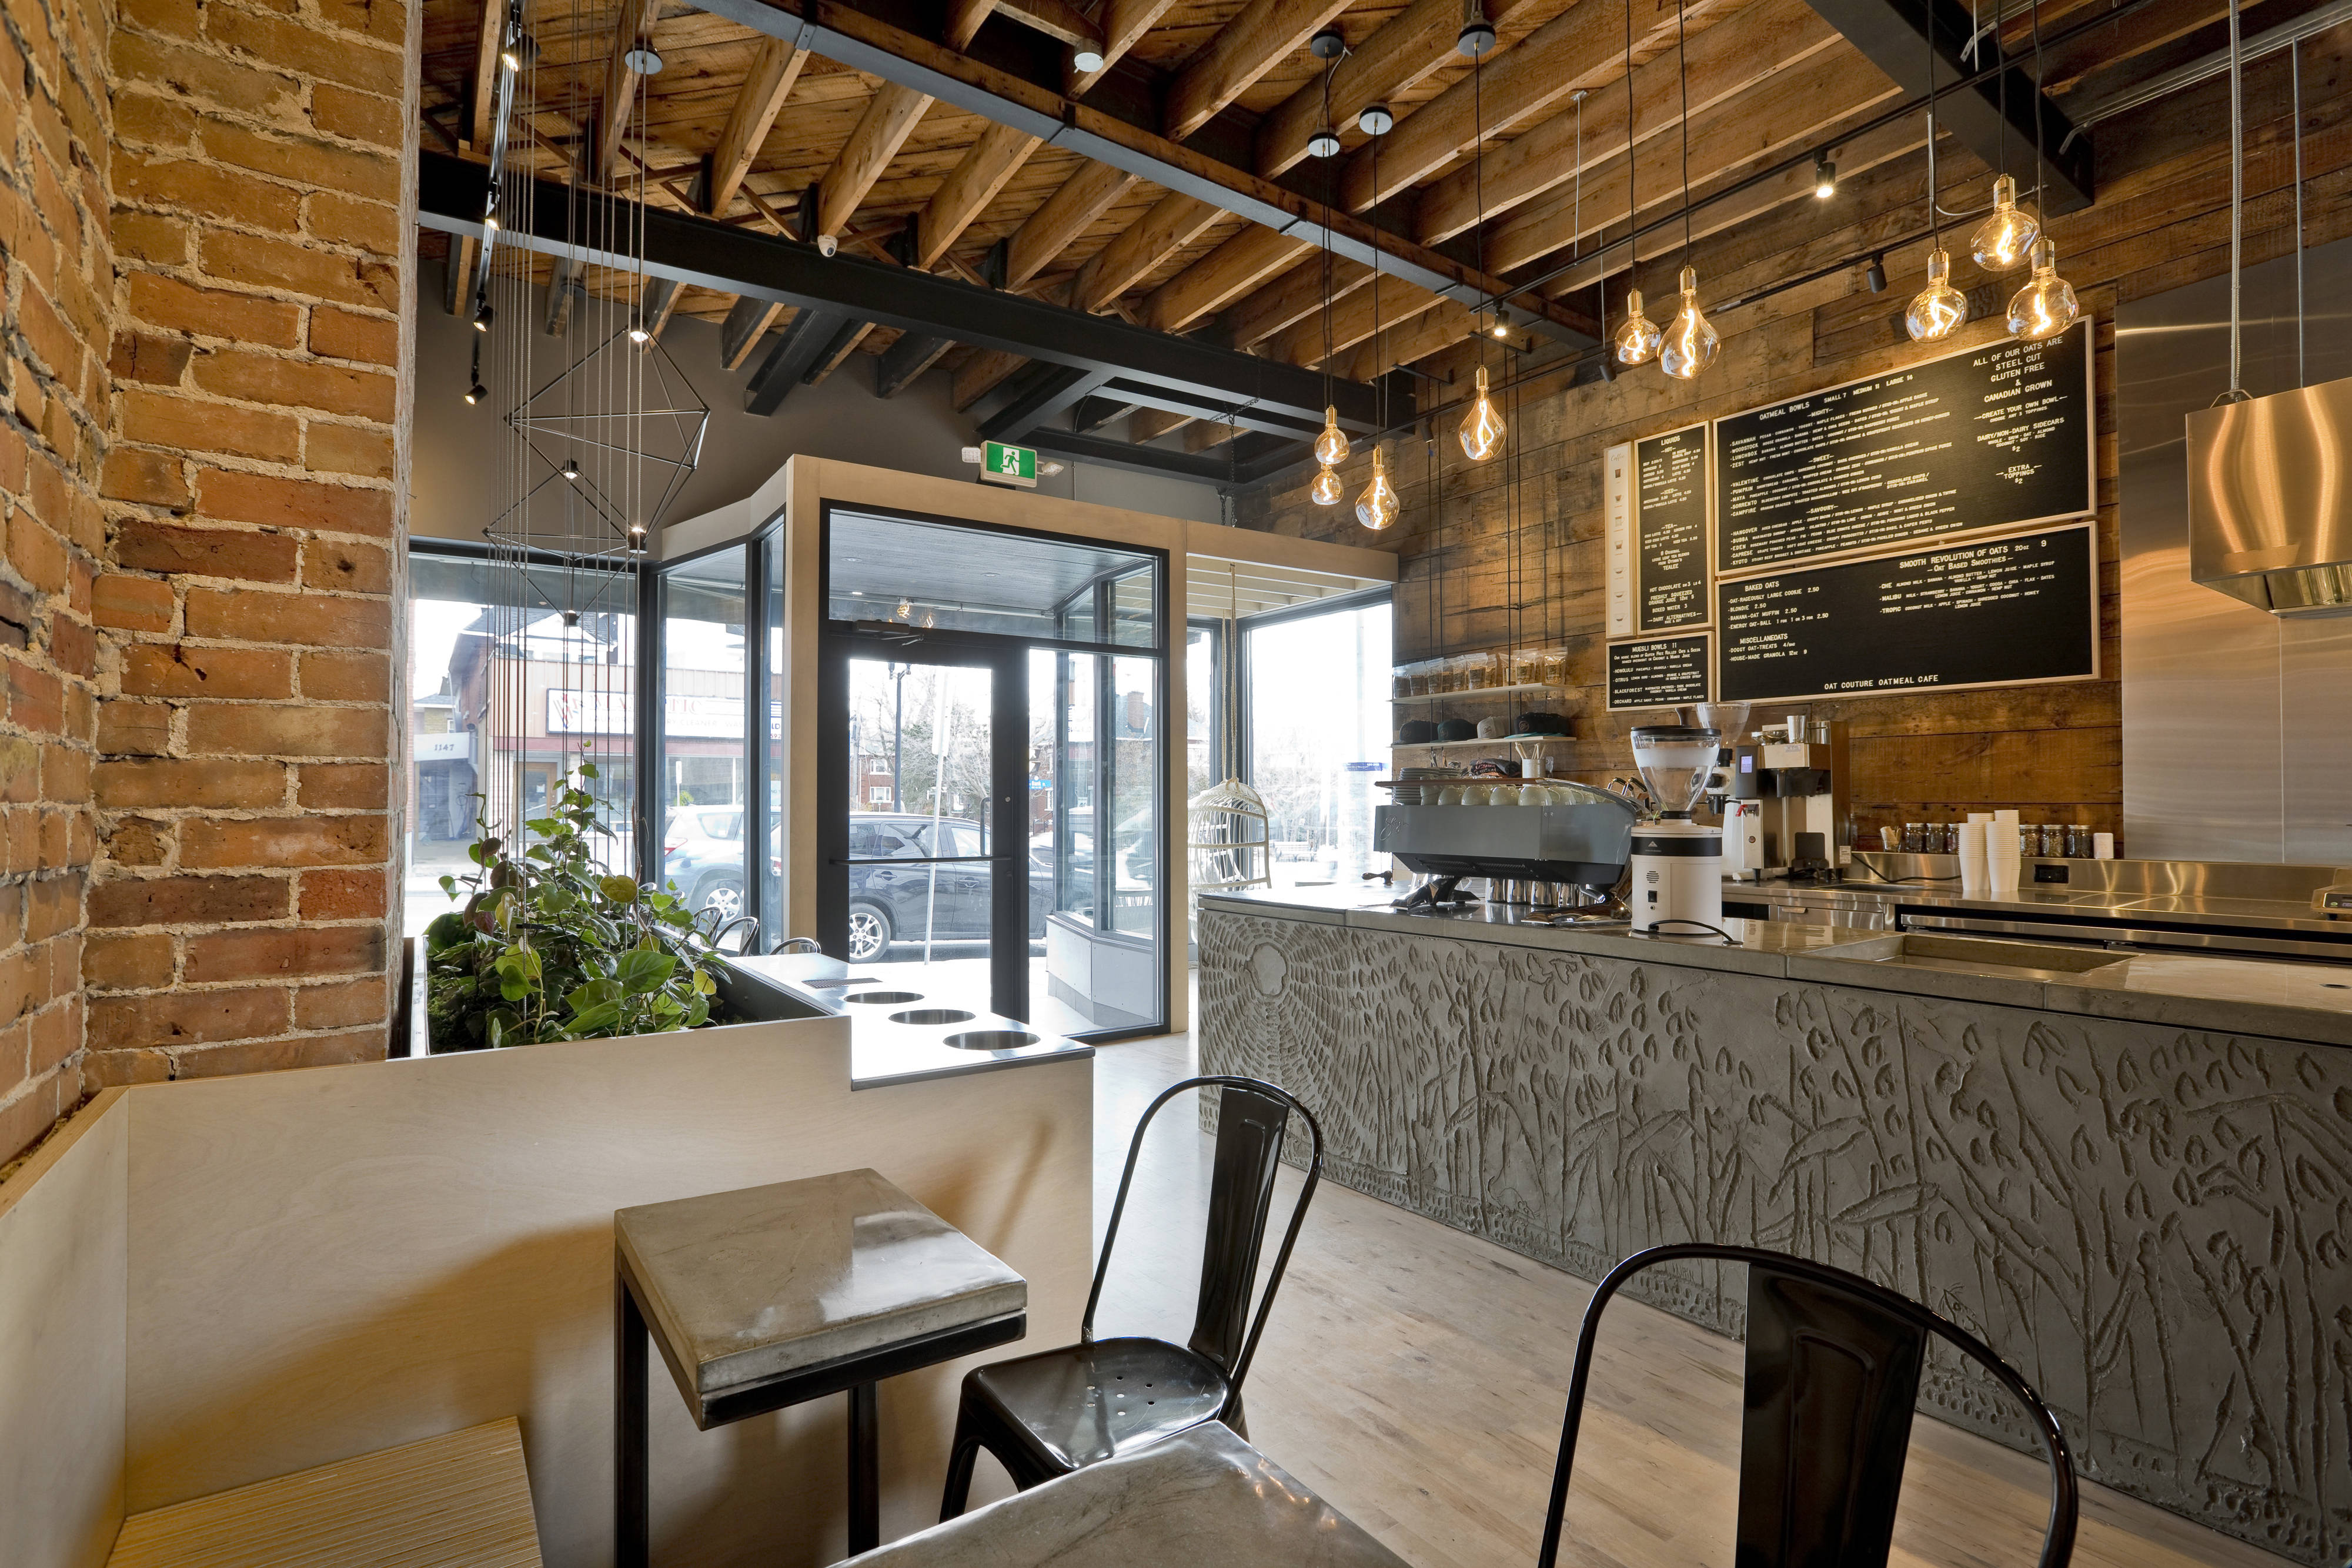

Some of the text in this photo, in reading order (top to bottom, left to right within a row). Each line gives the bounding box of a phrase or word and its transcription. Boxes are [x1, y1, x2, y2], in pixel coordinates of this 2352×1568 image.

[1973, 336, 2063, 366] ALL OF OUR OATS ARE
[1995, 352, 2042, 370] STEEL CUT
[1990, 362, 2044, 382] GLUTEN FREE
[1984, 379, 2052, 402] CANADIAN GROWN
[1759, 408, 1786, 420] OATMEAL
[1789, 401, 1809, 412] BOWLS
[1823, 394, 1841, 403] SMALL
[1853, 385, 1872, 395] MEDIUM
[1886, 376, 1904, 386] LARGE
[2006, 404, 2022, 413] YOUR
[2025, 400, 2039, 409] OWN
[2024, 405, 2047, 414] TOPPINGS
[1977, 417, 2064, 442] DAIRY/NON-DAIRY SIDECARS
[1661, 435, 1681, 446] LIQUIDS
[2003, 468, 2034, 479] TOPPINGS
[2008, 463, 2030, 473] EXTRA
[1899, 558, 1926, 569] SMOOTH
[1930, 550, 1974, 564] REVOLUTION
[1976, 549, 1987, 557] OF
[1989, 545, 2008, 554] OATS
[1948, 561, 1968, 570] BASED
[1970, 556, 2006, 566] SMOOTHIES
[1658, 583, 1681, 591] CHOCOLATE
[1745, 580, 1779, 591] BAKED OATS
[1671, 589, 1692, 597] SQUEEZED
[1740, 633, 1788, 644] MISCELLANEOATS
[1748, 643, 1778, 651] OAT-TREATS
[1841, 680, 1873, 688] COUTURE
[1878, 677, 1915, 686] OATMEAL
[1917, 674, 1938, 683] CAFE
